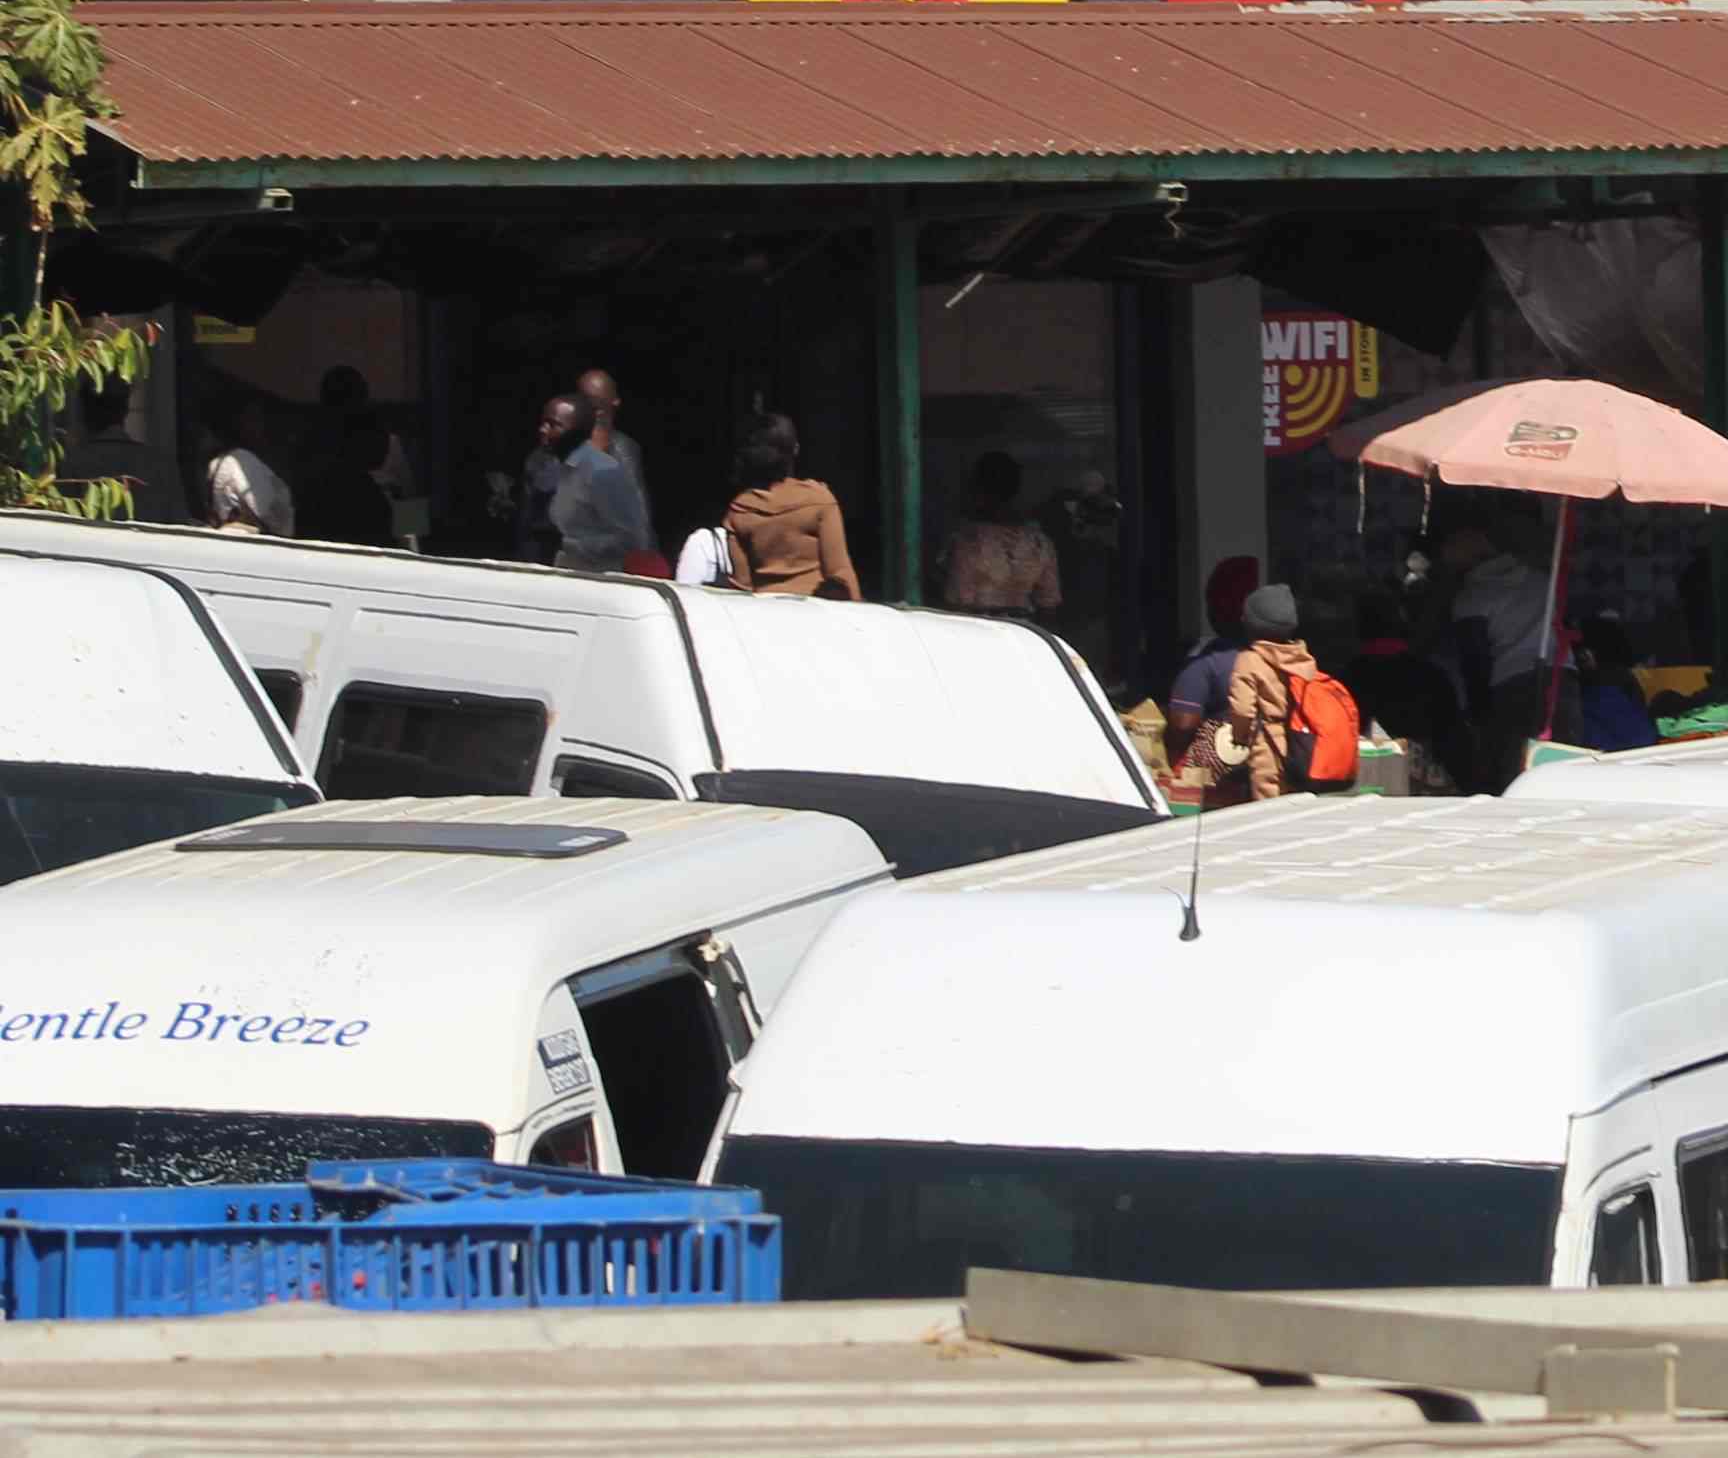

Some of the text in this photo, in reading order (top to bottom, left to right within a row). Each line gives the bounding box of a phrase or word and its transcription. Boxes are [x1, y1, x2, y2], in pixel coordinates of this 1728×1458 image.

[1261, 321, 1349, 360] WIFI
[0, 1001, 371, 1047] entle Breeze
